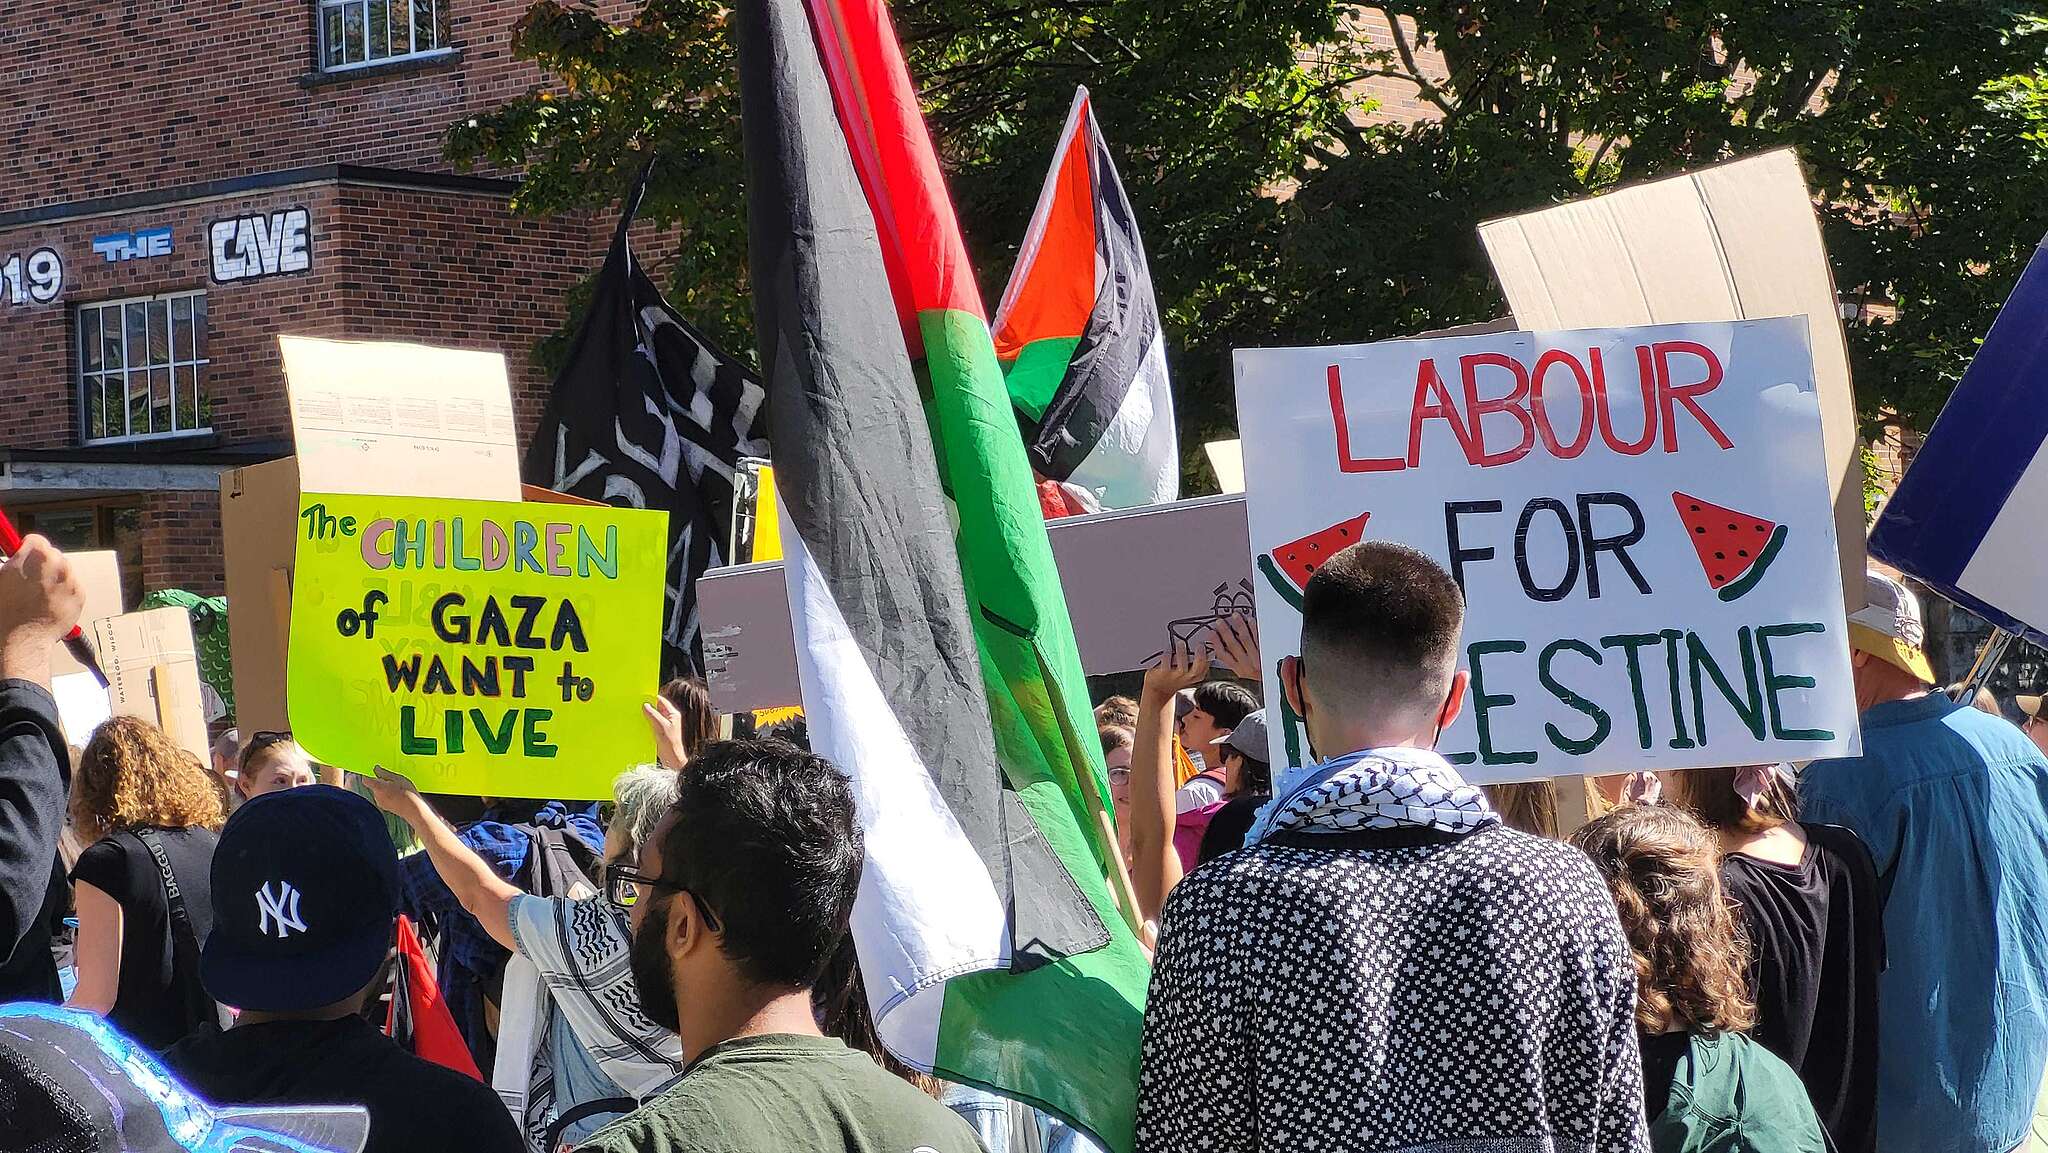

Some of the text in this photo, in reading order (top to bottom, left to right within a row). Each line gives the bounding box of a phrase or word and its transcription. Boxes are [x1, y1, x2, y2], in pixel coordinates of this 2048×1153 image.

[92, 207, 311, 283] THE CAVE
[1327, 341, 1735, 473] LABOUR
[301, 503, 618, 579] The CHILDREN
[1445, 492, 1652, 608] FOR
[336, 589, 389, 640] of
[430, 592, 590, 653] GAZA
[381, 653, 595, 702] WANT to
[400, 705, 558, 758] LIVE
[151, 843, 180, 899] BAGGU
